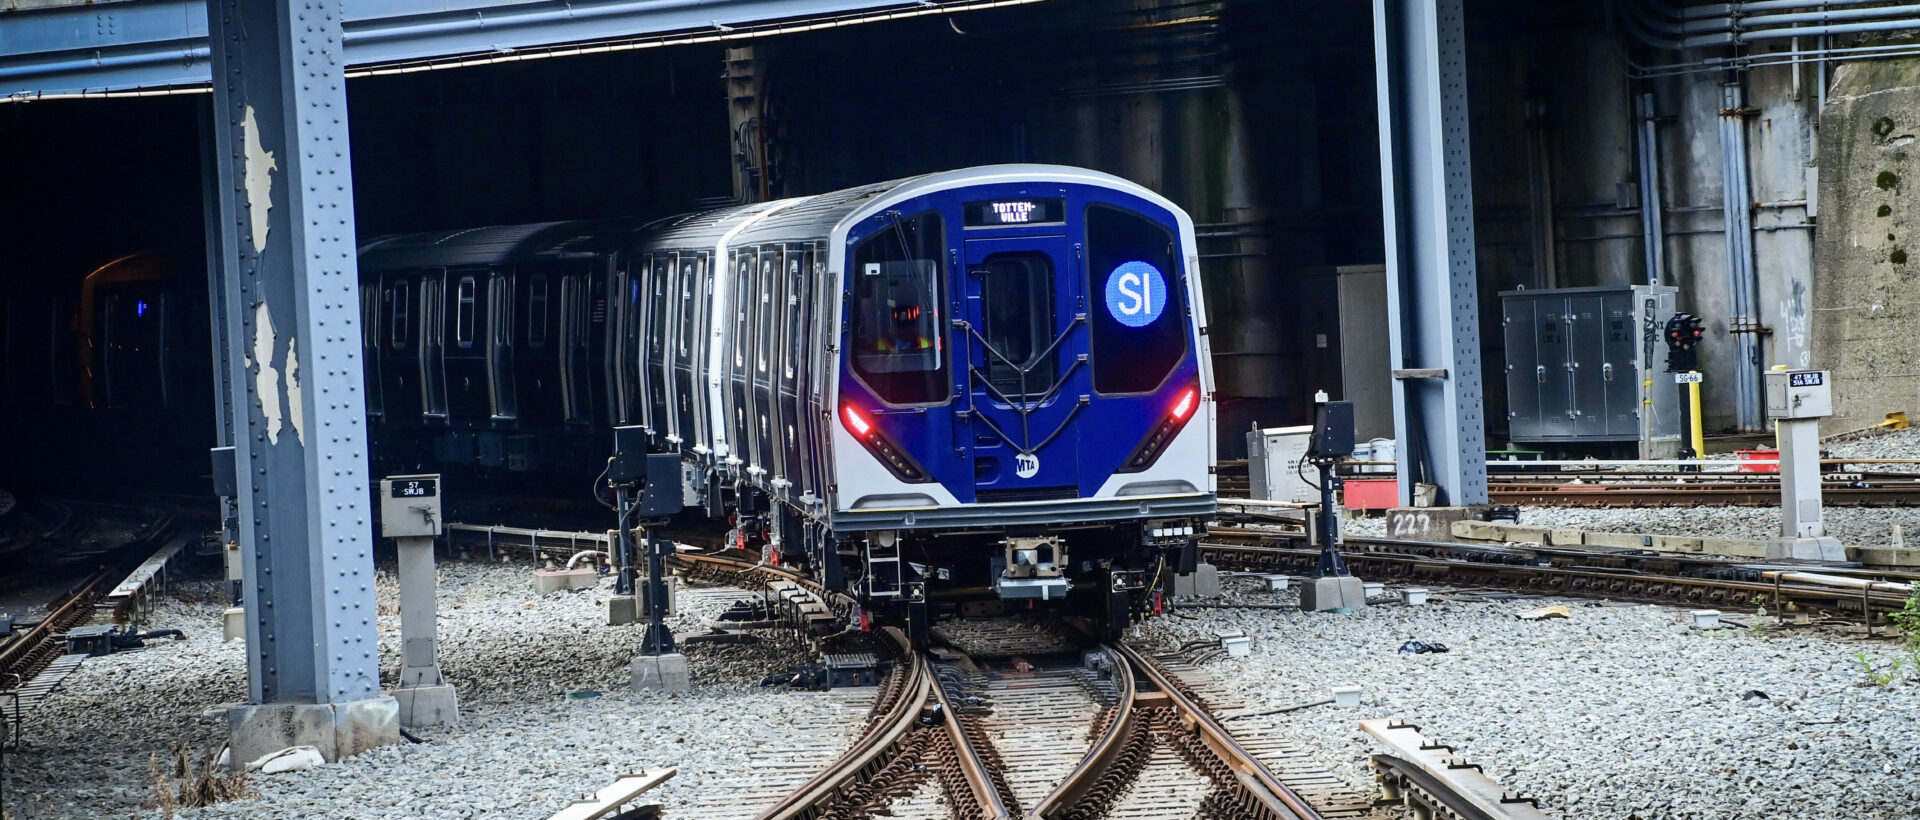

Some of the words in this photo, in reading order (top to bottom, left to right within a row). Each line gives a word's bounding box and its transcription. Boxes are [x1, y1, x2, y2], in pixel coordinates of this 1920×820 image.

[1001, 212, 1029, 223] VILLE
[1118, 272, 1151, 315] SI
[1679, 374, 1699, 383] SG-66
[1016, 458, 1035, 473] MTA
[408, 481, 419, 489] 57
[403, 487, 424, 496] SWJB
[1393, 513, 1430, 537] 227
